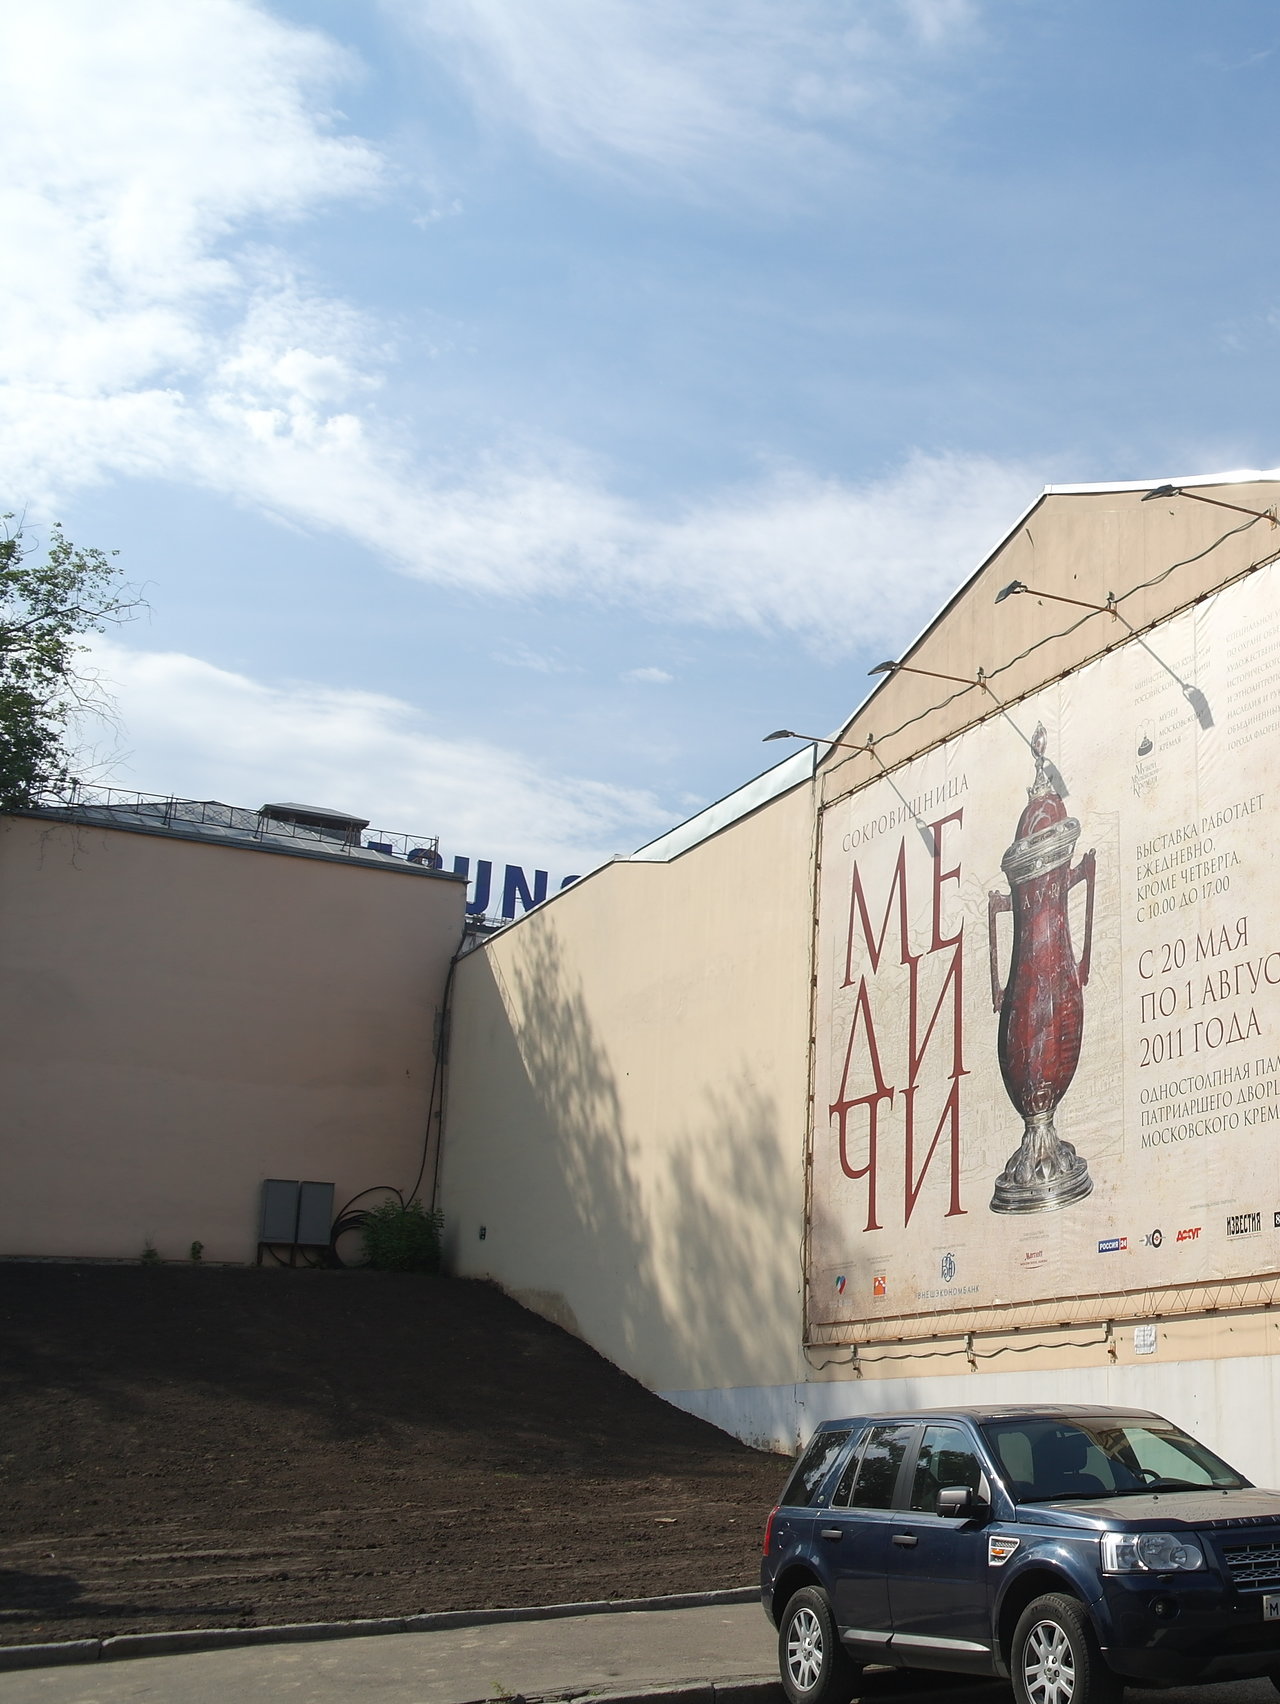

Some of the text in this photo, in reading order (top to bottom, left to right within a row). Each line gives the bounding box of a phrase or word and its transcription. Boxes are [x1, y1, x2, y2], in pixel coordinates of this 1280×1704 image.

[842, 773, 969, 853] СОКРОВИЩНИЦА
[1136, 793, 1265, 861] ВЫСТАВКА РАБОТАЕТ
[1136, 850, 1242, 902] КРОМЕ ЧЕТВЕРГА,
[1136, 875, 1230, 923] С 10.00 ДО 17.00
[1138, 915, 1249, 980] С 20 МАЯ
[1140, 986, 1177, 1024] ПО
[1185, 980, 1193, 1011] 1
[1139, 1007, 1262, 1068] 2011 ГОДА
[1140, 1062, 1250, 1105] ОДНОСТОЛПНАЯ
[1140, 1090, 1233, 1127] ПАТРИАРШЕГО
[1140, 1112, 1240, 1149] МОСКОВСКОГО
[1099, 1239, 1120, 1252] РОССИЯ
[1226, 1211, 1262, 1236] ИЗВЕСТИЯ
[917, 1284, 980, 1300] ВНЕШЭКОНОМБАНК
